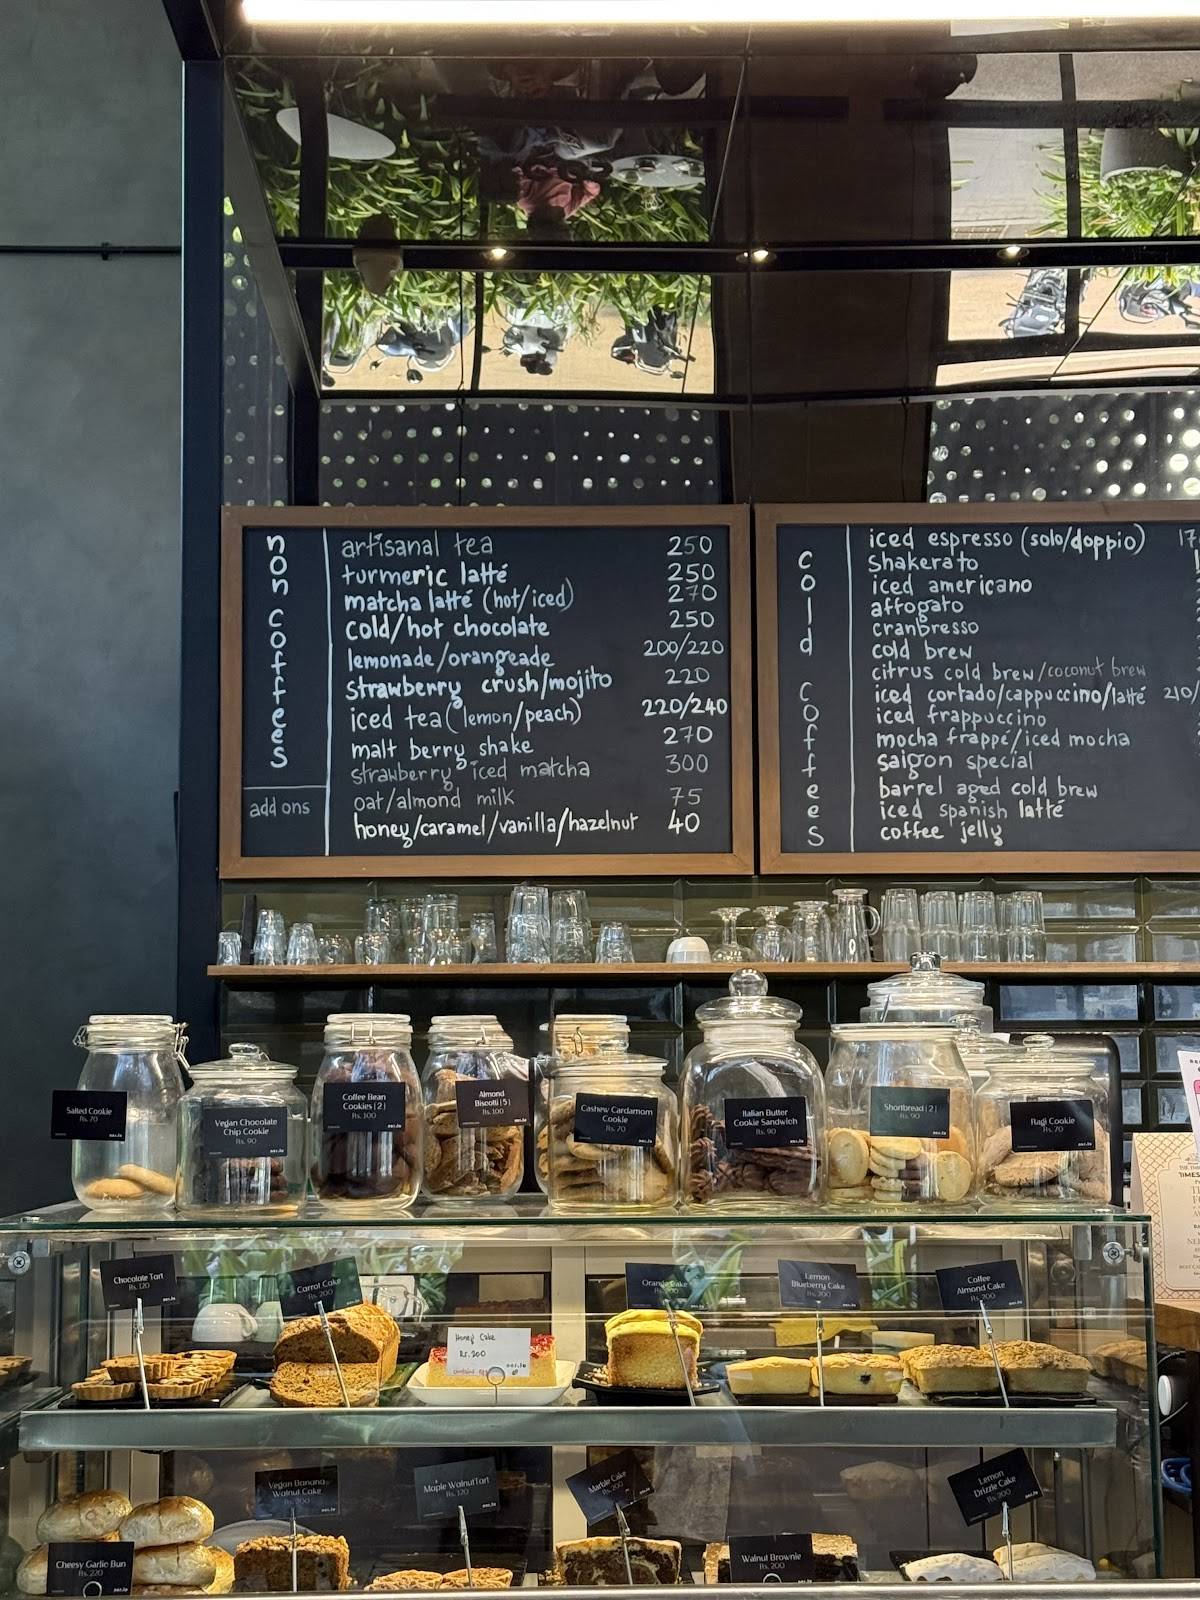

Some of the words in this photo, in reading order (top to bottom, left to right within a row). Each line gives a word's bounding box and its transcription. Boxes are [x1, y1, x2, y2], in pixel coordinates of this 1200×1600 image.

[342, 530, 439, 558] artisanal
[454, 532, 492, 555] tea
[667, 535, 712, 556] 250
[869, 527, 914, 548] iced
[928, 530, 1012, 554] espresso
[342, 564, 447, 586] turmeric
[668, 563, 715, 583] 250
[873, 574, 913, 595] iced
[929, 575, 1032, 595] americano
[345, 590, 420, 612] matcha
[483, 577, 574, 614] (hot/iced)
[669, 584, 718, 602] 270
[871, 596, 964, 623] affogato
[454, 613, 550, 638] chocolate
[669, 610, 714, 629] 250
[873, 620, 979, 638] cranbresso
[348, 642, 554, 676] lemonade/orangeade
[643, 633, 724, 662] 200/220
[873, 641, 909, 659] cold
[925, 640, 972, 660] brew
[872, 661, 933, 681] citrus
[944, 663, 980, 681] cold
[1111, 656, 1146, 677] brew
[481, 666, 612, 699] crush/mojito
[665, 667, 710, 685] 220
[875, 683, 912, 703] iced
[351, 704, 392, 731] iced
[642, 693, 727, 720] 220/240
[877, 706, 913, 725] iced
[927, 706, 1046, 731] frappuccino
[877, 730, 938, 747] mocha
[1069, 732, 1130, 747] mocha
[352, 742, 396, 760] malt
[410, 742, 466, 771] berry
[479, 733, 533, 757] shake
[663, 726, 712, 745] 270
[352, 763, 452, 790] strawberry
[473, 759, 507, 781] iced
[520, 756, 590, 778] matcha
[666, 754, 708, 774] 300
[878, 751, 952, 779] saigon
[966, 751, 1033, 778] special
[880, 776, 942, 797] barrel
[956, 776, 1000, 803] aged
[1011, 777, 1047, 797] cold
[1058, 777, 1097, 798] brew
[354, 788, 460, 814] oat/almond
[477, 788, 514, 806] milk
[670, 788, 703, 806] 75
[881, 800, 922, 819] iced
[939, 801, 1007, 827] spanish
[668, 810, 700, 834] 40
[881, 823, 944, 840] coffee
[960, 821, 1003, 846] jelly
[479, 1090, 504, 1098] Almond
[66, 1107, 87, 1115] Salted
[581, 1105, 609, 1113] Cashew
[611, 1106, 653, 1115] Cardamom
[742, 1109, 764, 1117] Italian
[766, 1109, 788, 1117] Butter
[884, 1104, 924, 1112] Shortbread
[215, 1119, 238, 1128] Vegan
[240, 1118, 277, 1126] Chocolate
[603, 1115, 628, 1124] Cookie
[734, 1119, 759, 1127] Cookie
[761, 1118, 798, 1126] Sandwich
[1031, 1118, 1047, 1127] Ragi
[243, 1127, 269, 1135] Cookie
[114, 1275, 148, 1284] Chocolate
[804, 1272, 830, 1281] Lemon
[967, 1275, 991, 1283] Coffee
[297, 1282, 321, 1294] Carrot
[322, 1278, 341, 1288] Cake
[792, 1281, 826, 1290] Blueberry
[957, 1285, 986, 1294] Almond
[988, 1282, 1005, 1290] Cake
[480, 1333, 495, 1341] Cake
[268, 1480, 293, 1489] Vegan
[294, 1479, 326, 1487] Banana
[979, 1470, 1004, 1486] Lemon
[998, 1476, 1016, 1491] Cake
[272, 1488, 300, 1498] Walnut
[302, 1488, 322, 1496] Cake
[424, 1481, 447, 1494] Maple
[56, 1561, 84, 1570] Cheesy
[86, 1560, 108, 1568] Garlic
[110, 1560, 126, 1568] Bun
[741, 1554, 768, 1563] Walnut
[770, 1552, 801, 1562] Brownie
